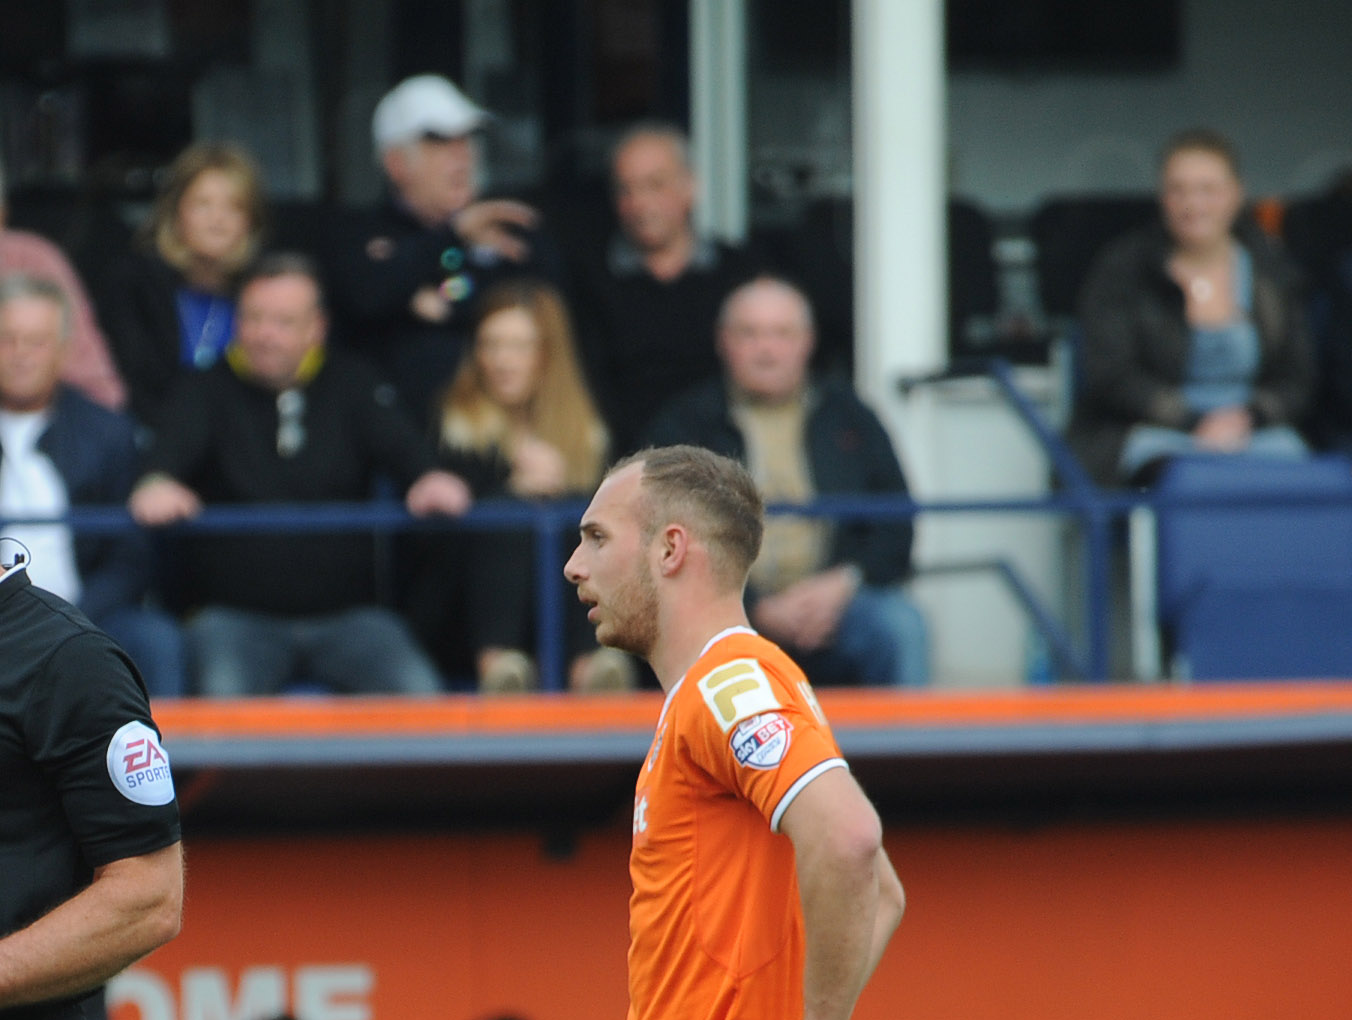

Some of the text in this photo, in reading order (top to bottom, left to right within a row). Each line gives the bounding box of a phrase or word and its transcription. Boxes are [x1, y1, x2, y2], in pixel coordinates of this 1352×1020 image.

[123, 738, 166, 774] EA
[737, 738, 757, 761] sky
[757, 719, 786, 742] BET
[126, 766, 169, 789] SPORTS
